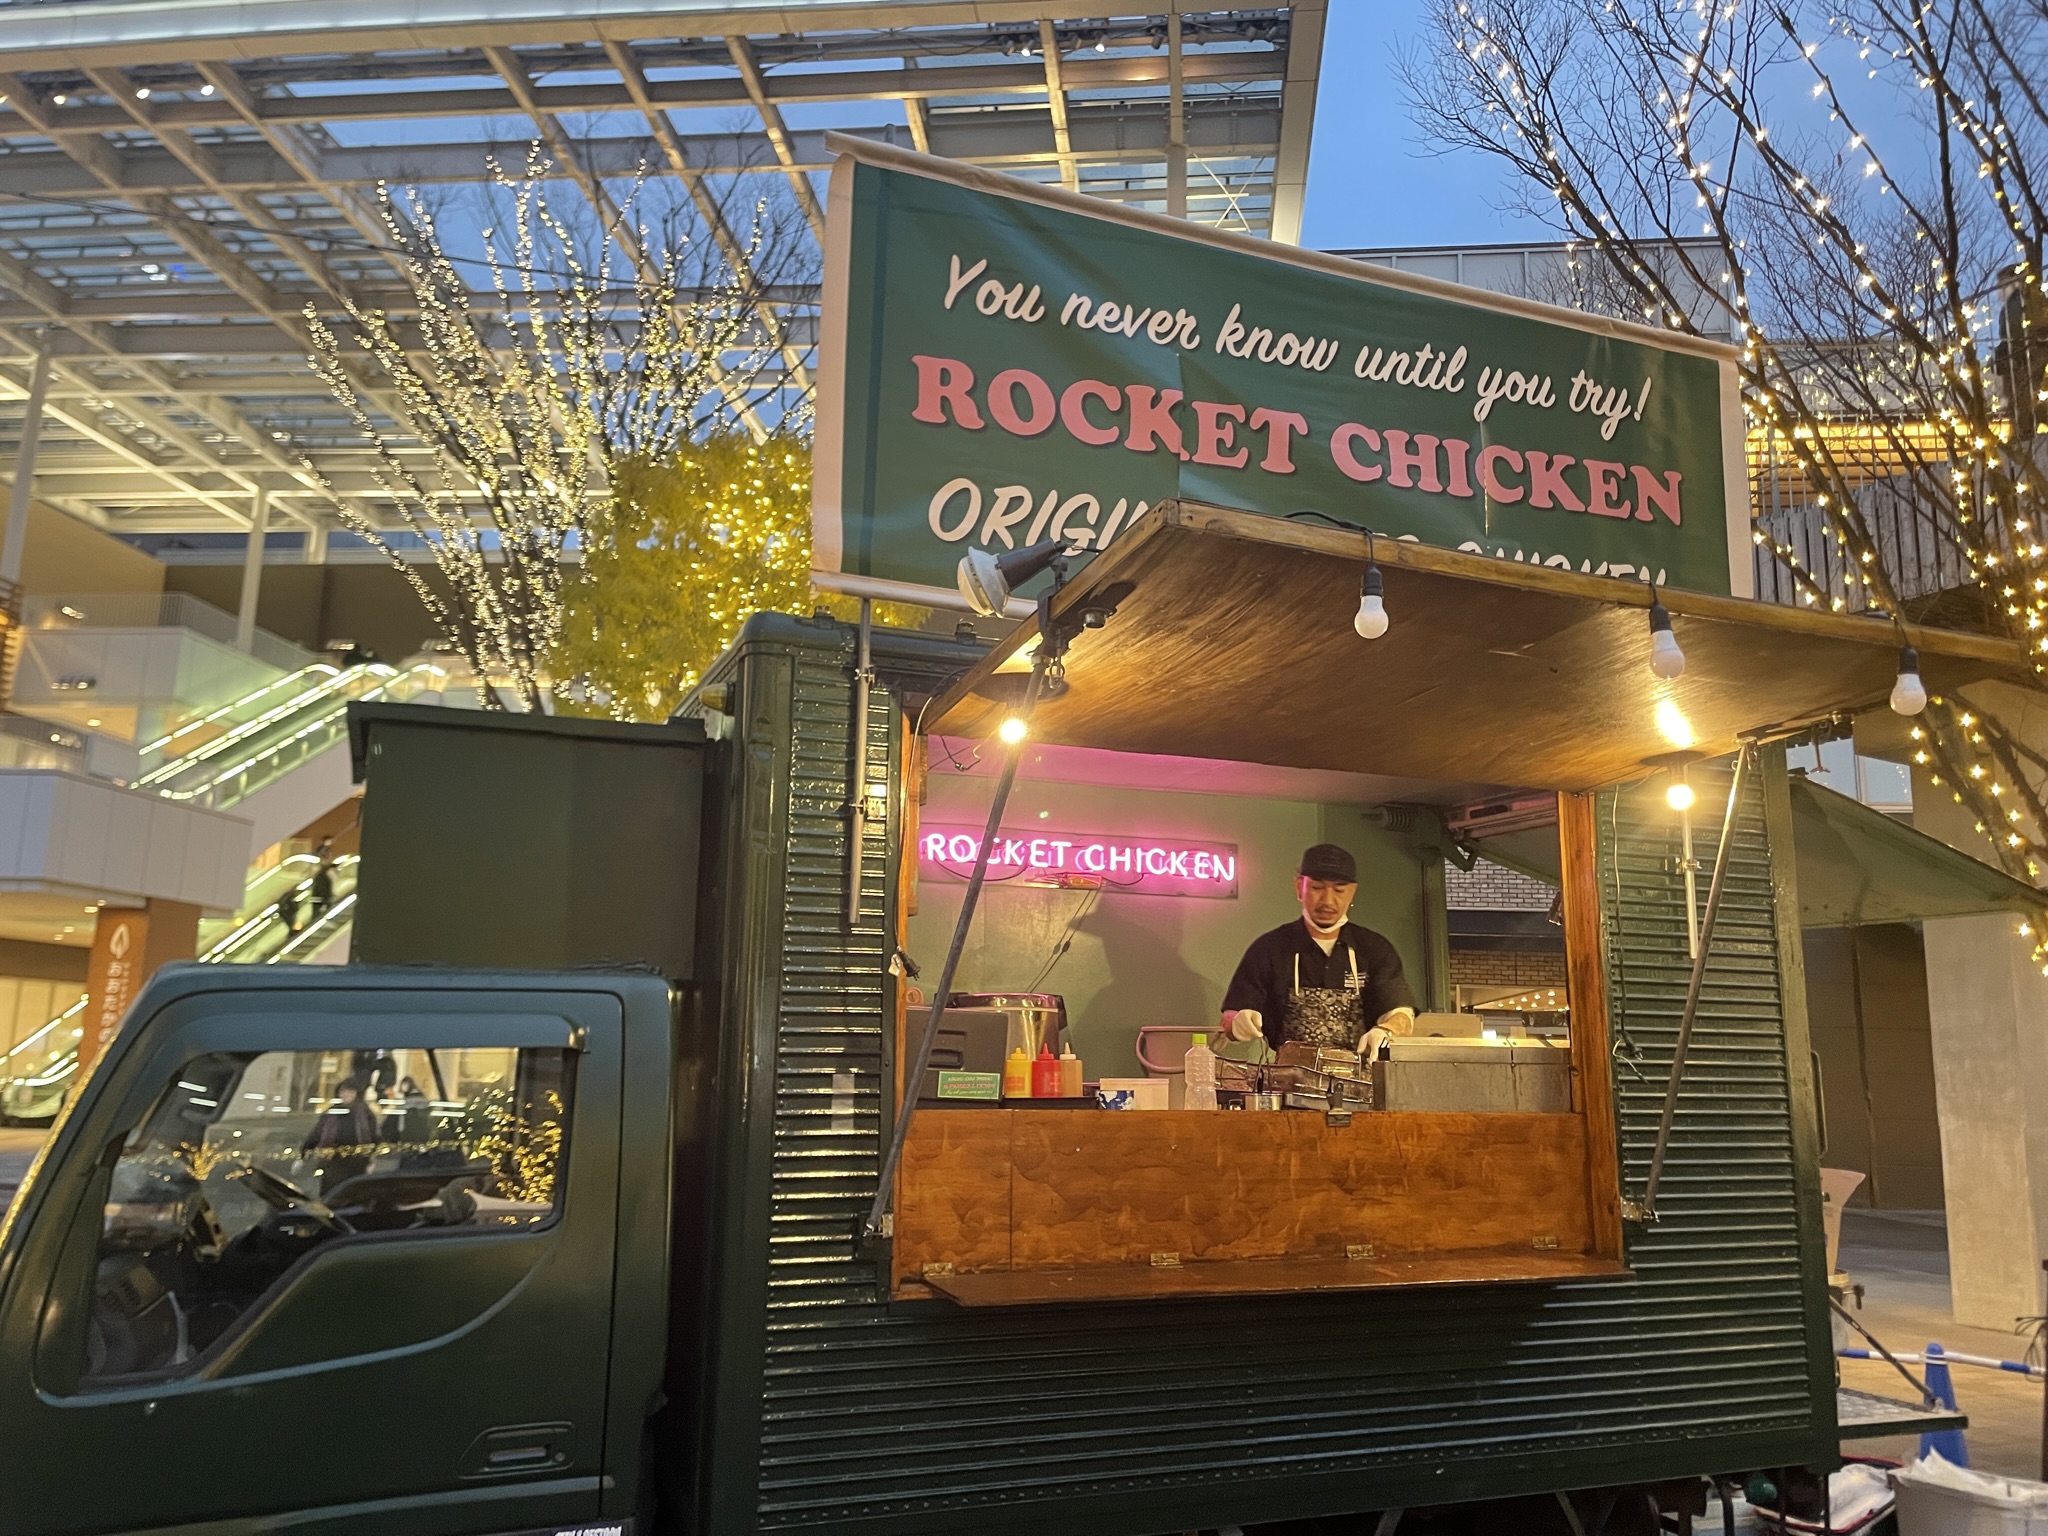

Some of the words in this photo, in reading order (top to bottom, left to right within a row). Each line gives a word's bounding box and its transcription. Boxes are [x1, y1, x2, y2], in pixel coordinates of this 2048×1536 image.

[944, 254, 1046, 323] You
[1060, 292, 1200, 350] never
[1215, 303, 1339, 372] know
[1354, 342, 1468, 393] until
[1473, 366, 1556, 422] you
[1569, 369, 1652, 441] try!
[911, 354, 1309, 474] ROCKET
[1330, 422, 1683, 526] CHICKEN
[928, 477, 1149, 557] ORIGI
[1085, 844, 1236, 882] CHICKEN
[98, 961, 123, 1049] おおたかの
